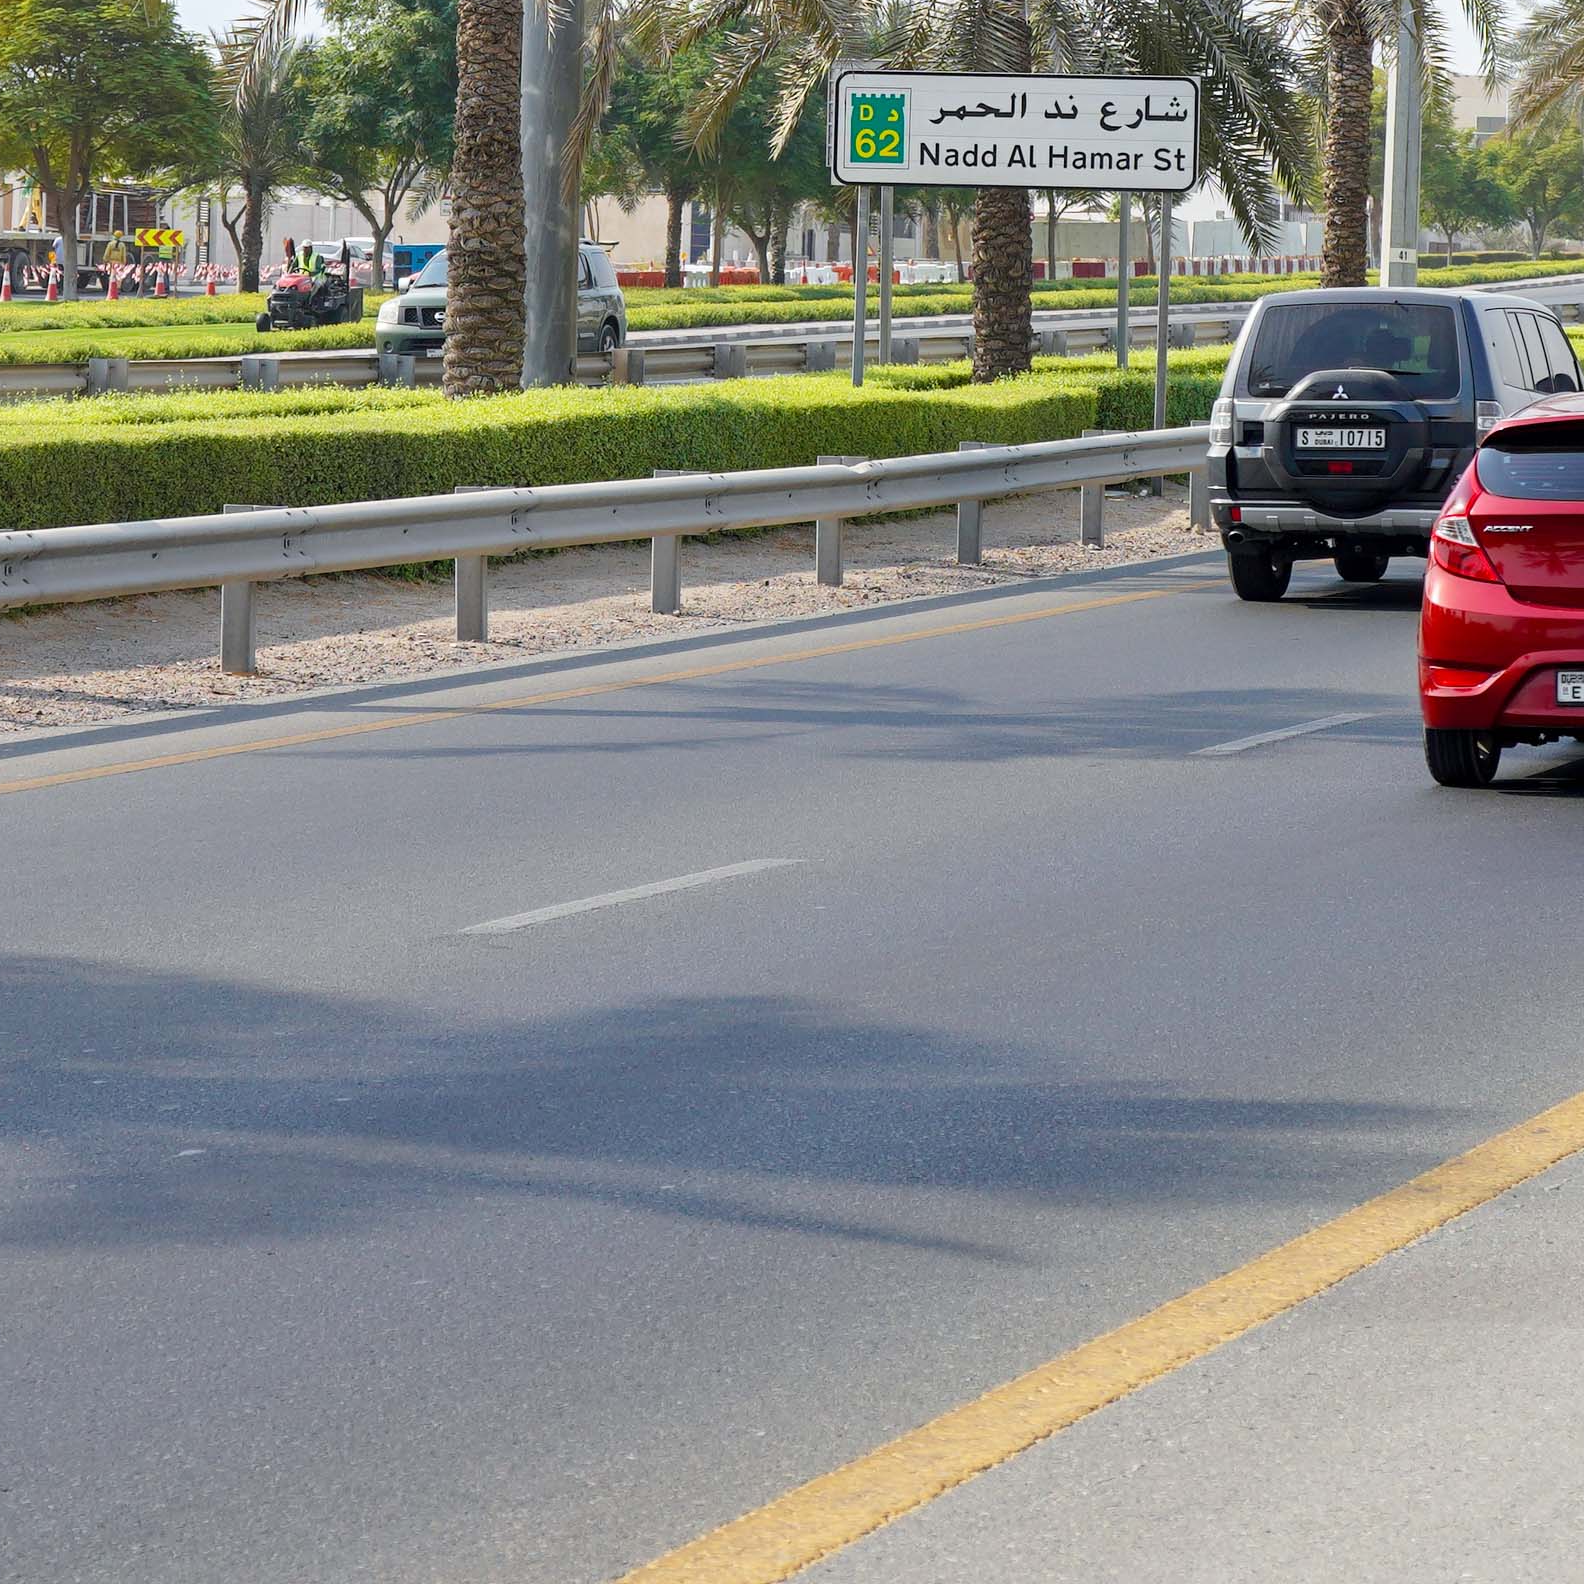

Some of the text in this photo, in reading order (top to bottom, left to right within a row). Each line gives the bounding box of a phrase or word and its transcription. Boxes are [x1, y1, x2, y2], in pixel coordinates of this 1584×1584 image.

[859, 105, 874, 121] D
[887, 108, 900, 122] د
[930, 93, 1188, 131] شارع ند الحمر
[855, 129, 899, 158] 62
[920, 142, 1186, 172] Nadd Al Hamar St
[1399, 250, 1408, 261] 41
[1302, 430, 1382, 446] S 10715
[1572, 686, 1582, 699] E
